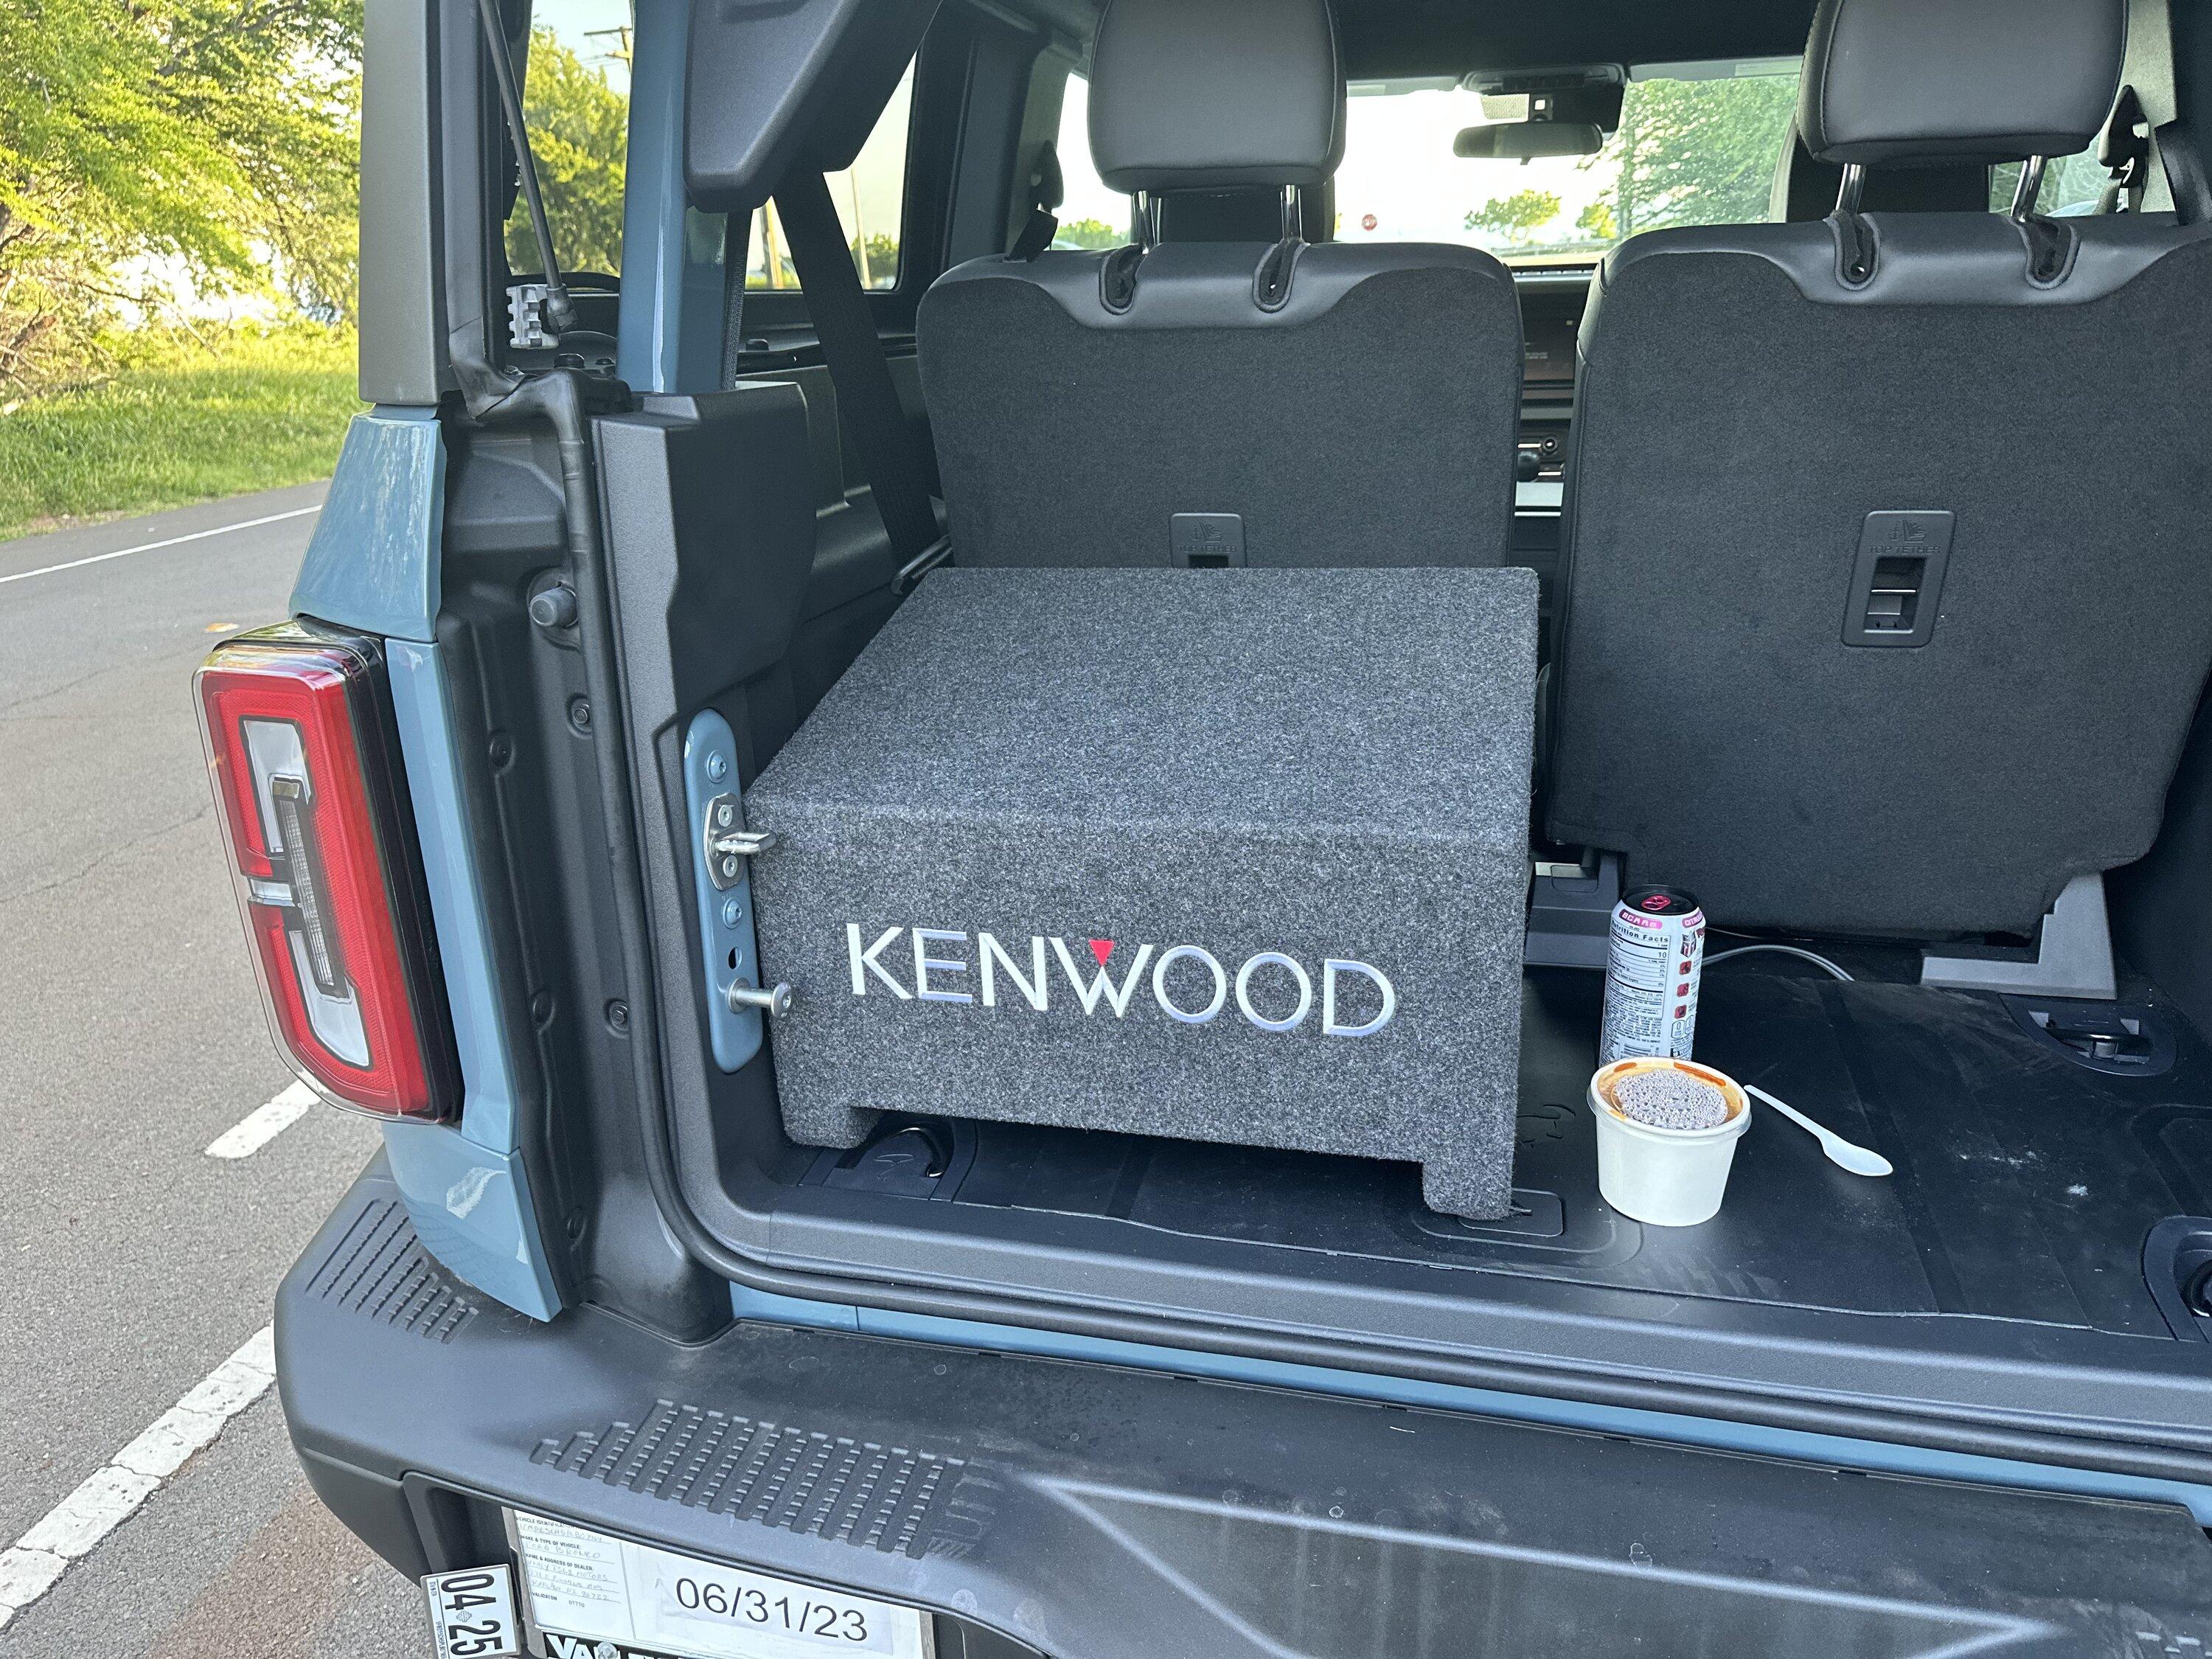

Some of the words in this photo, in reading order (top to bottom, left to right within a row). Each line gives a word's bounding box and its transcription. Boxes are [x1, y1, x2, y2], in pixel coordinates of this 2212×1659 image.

[1870, 546, 1891, 554] TOP
[1896, 546, 1940, 554] TETHER
[846, 923, 1395, 1037] KENWOOD
[544, 1557, 566, 1566] ADDRESS
[441, 1573, 496, 1610] 04
[676, 1578, 867, 1641] 06/31/23
[448, 1620, 503, 1655] 25
